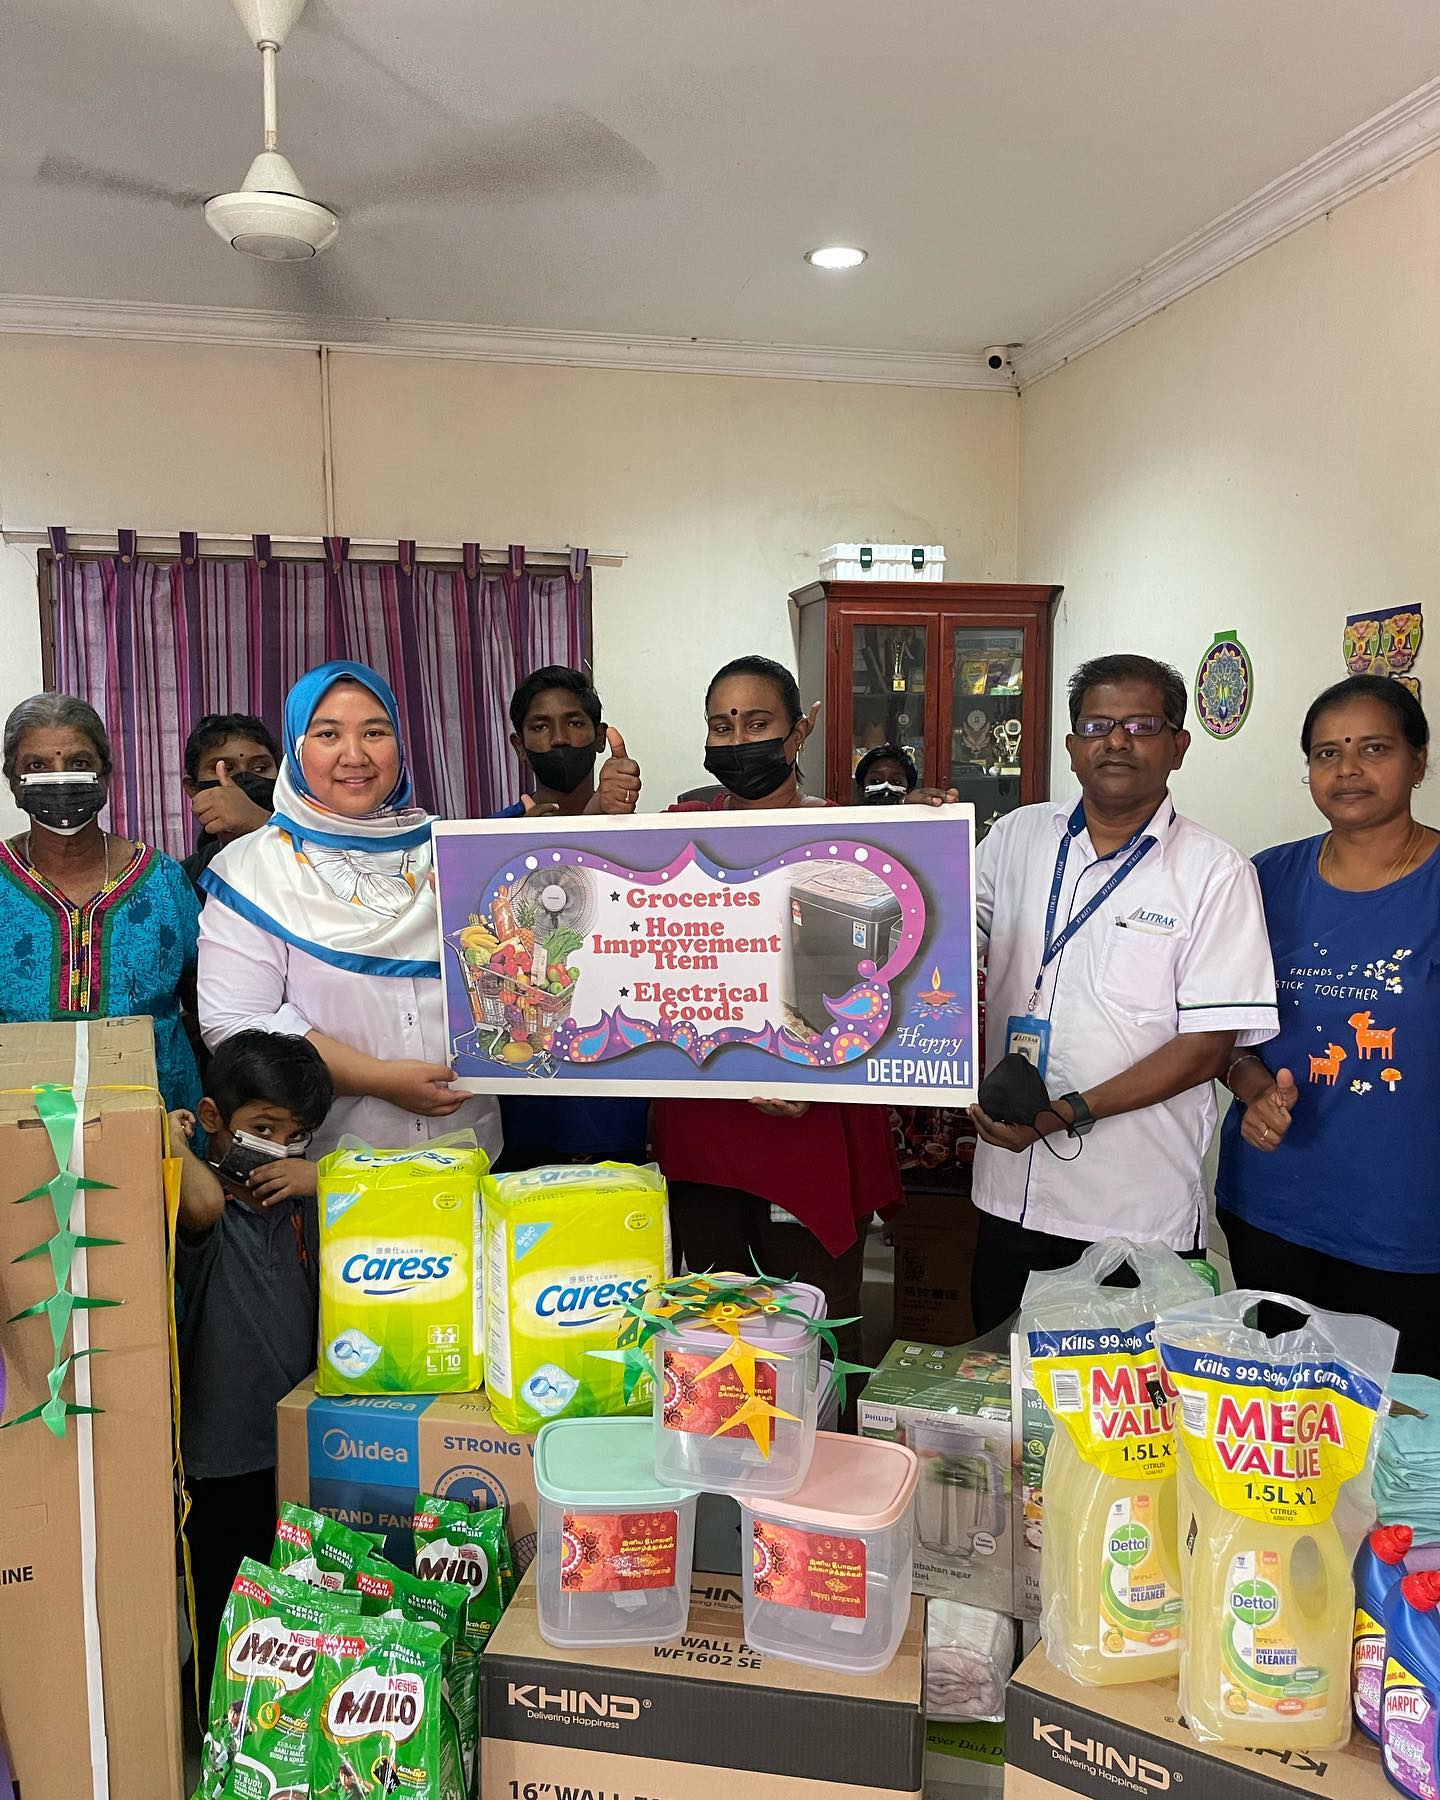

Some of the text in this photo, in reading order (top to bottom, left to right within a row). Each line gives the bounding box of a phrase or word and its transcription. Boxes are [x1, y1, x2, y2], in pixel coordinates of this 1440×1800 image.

[626, 887, 761, 908] Groceries
[645, 917, 725, 937] Home
[1139, 911, 1177, 927] LITRAK
[592, 934, 781, 958] Improvement
[655, 951, 719, 970] Item
[1290, 967, 1333, 976] FRIENDS
[633, 982, 768, 1002] Electrical
[1275, 979, 1378, 1000] STICK TOGETHER
[659, 1001, 744, 1021] Goods
[896, 1023, 963, 1057] Happy
[866, 1058, 969, 1085] DEEPAVALI
[342, 1253, 453, 1284] Caress
[535, 1278, 648, 1317] Caress
[1061, 1337, 1095, 1351] Kills
[426, 1355, 437, 1368] L
[444, 1354, 461, 1367] 10
[1194, 1358, 1231, 1378] Kills
[1293, 1369, 1310, 1383] of
[344, 1398, 417, 1411] Midea
[865, 1413, 894, 1424] PHILIPS
[1216, 1397, 1342, 1446] MEGA
[335, 1439, 408, 1463] Midea
[443, 1436, 521, 1456] STRONG
[1122, 1443, 1159, 1462] 1.5L
[1143, 1462, 1165, 1470] CITRUS
[1216, 1441, 1321, 1479] VALUE
[1244, 1483, 1290, 1505] 1.5L
[379, 1513, 412, 1529] FAN
[1270, 1508, 1297, 1516] CITRUS
[1111, 1538, 1149, 1552] Dettol
[0, 1566, 33, 1585] INE
[417, 1557, 483, 1587] MILO
[950, 1570, 972, 1579] agar
[360, 1576, 388, 1590] WAJAH
[1130, 1588, 1166, 1603] CLEANER
[1232, 1594, 1276, 1610] Dettol
[680, 1636, 733, 1653] WALL
[236, 1632, 317, 1677] MILO
[653, 1646, 762, 1670] WF1602 SE
[1255, 1655, 1297, 1666] CLEANER
[334, 1690, 417, 1726] MILO
[507, 1683, 640, 1720] KHIND
[1386, 1695, 1419, 1714] HARPIC
[527, 1710, 620, 1729] Delivering Happiness
[927, 1735, 954, 1745] ayer
[958, 1739, 987, 1753] Dish
[1032, 1716, 1170, 1791] KHIND
[1052, 1749, 1148, 1795] Delivering Happiness
